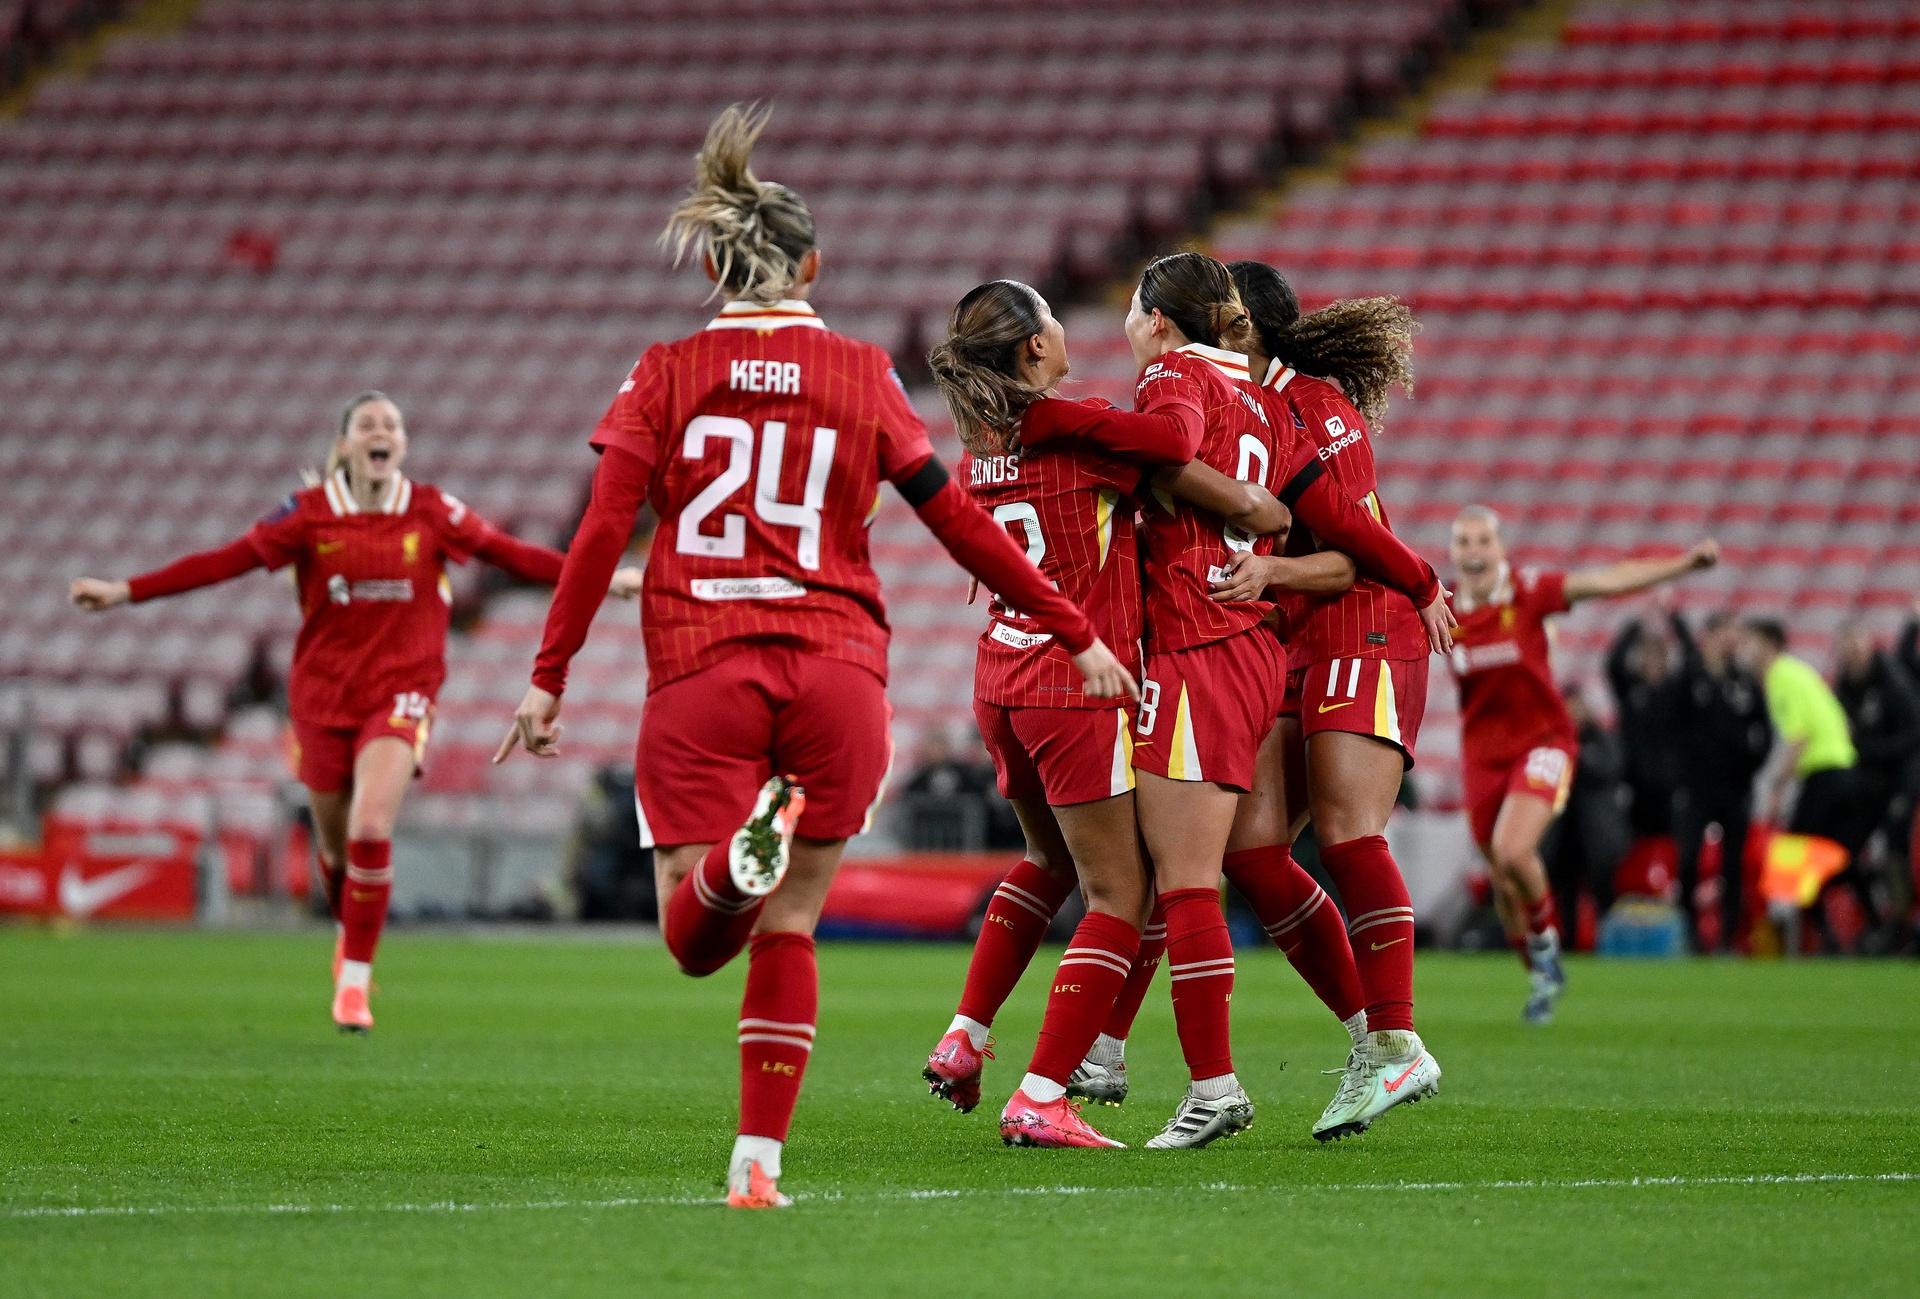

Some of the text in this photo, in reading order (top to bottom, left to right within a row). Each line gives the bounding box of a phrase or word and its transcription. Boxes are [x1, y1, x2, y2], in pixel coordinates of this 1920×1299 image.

[730, 360, 801, 394] KERR
[1318, 429, 1362, 461] Expedia
[970, 455, 1019, 486] HINDS
[676, 415, 837, 571] 24
[1000, 628, 1048, 647] Founatio
[1326, 659, 1362, 698] 11
[1136, 679, 1161, 736] 8
[988, 913, 1014, 930] LFC
[1054, 984, 1081, 993] LFC
[761, 1061, 797, 1078] LFC
